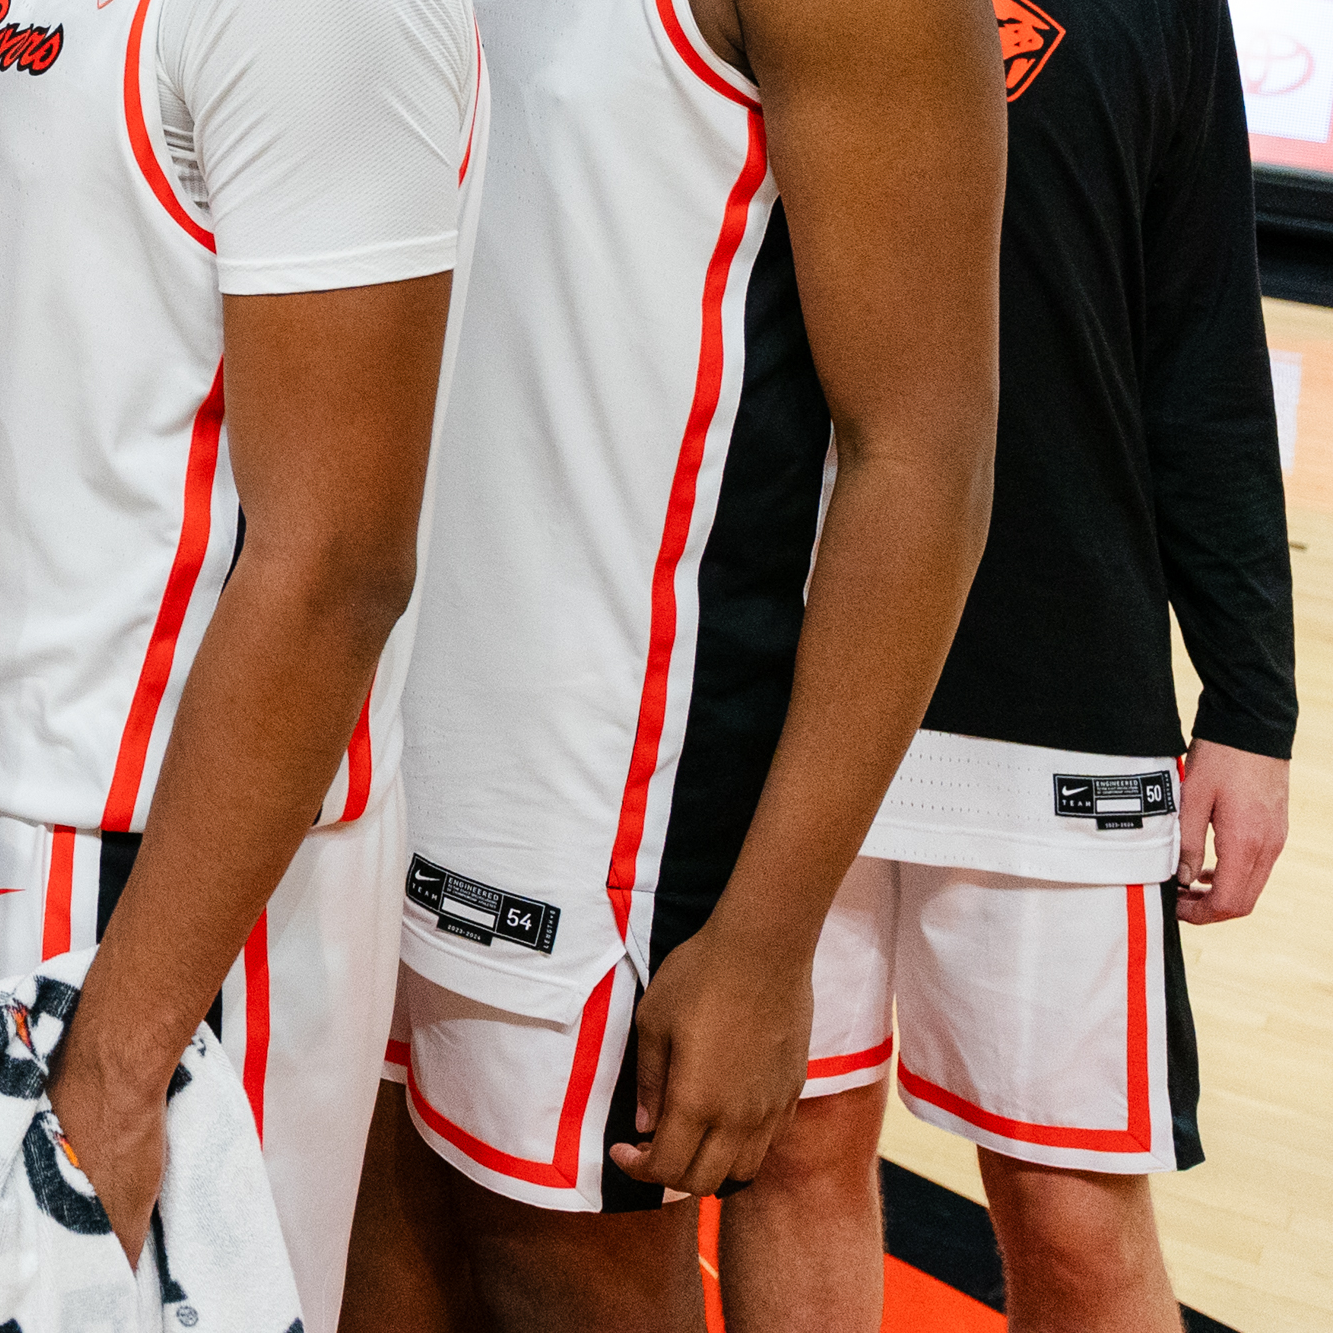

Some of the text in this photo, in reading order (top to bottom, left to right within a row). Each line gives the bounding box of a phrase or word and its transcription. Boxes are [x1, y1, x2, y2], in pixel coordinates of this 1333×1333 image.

[1146, 785, 1162, 803] 50
[411, 882, 438, 902] TEAM
[448, 877, 500, 902] ENGINEERED
[506, 908, 533, 931] 54
